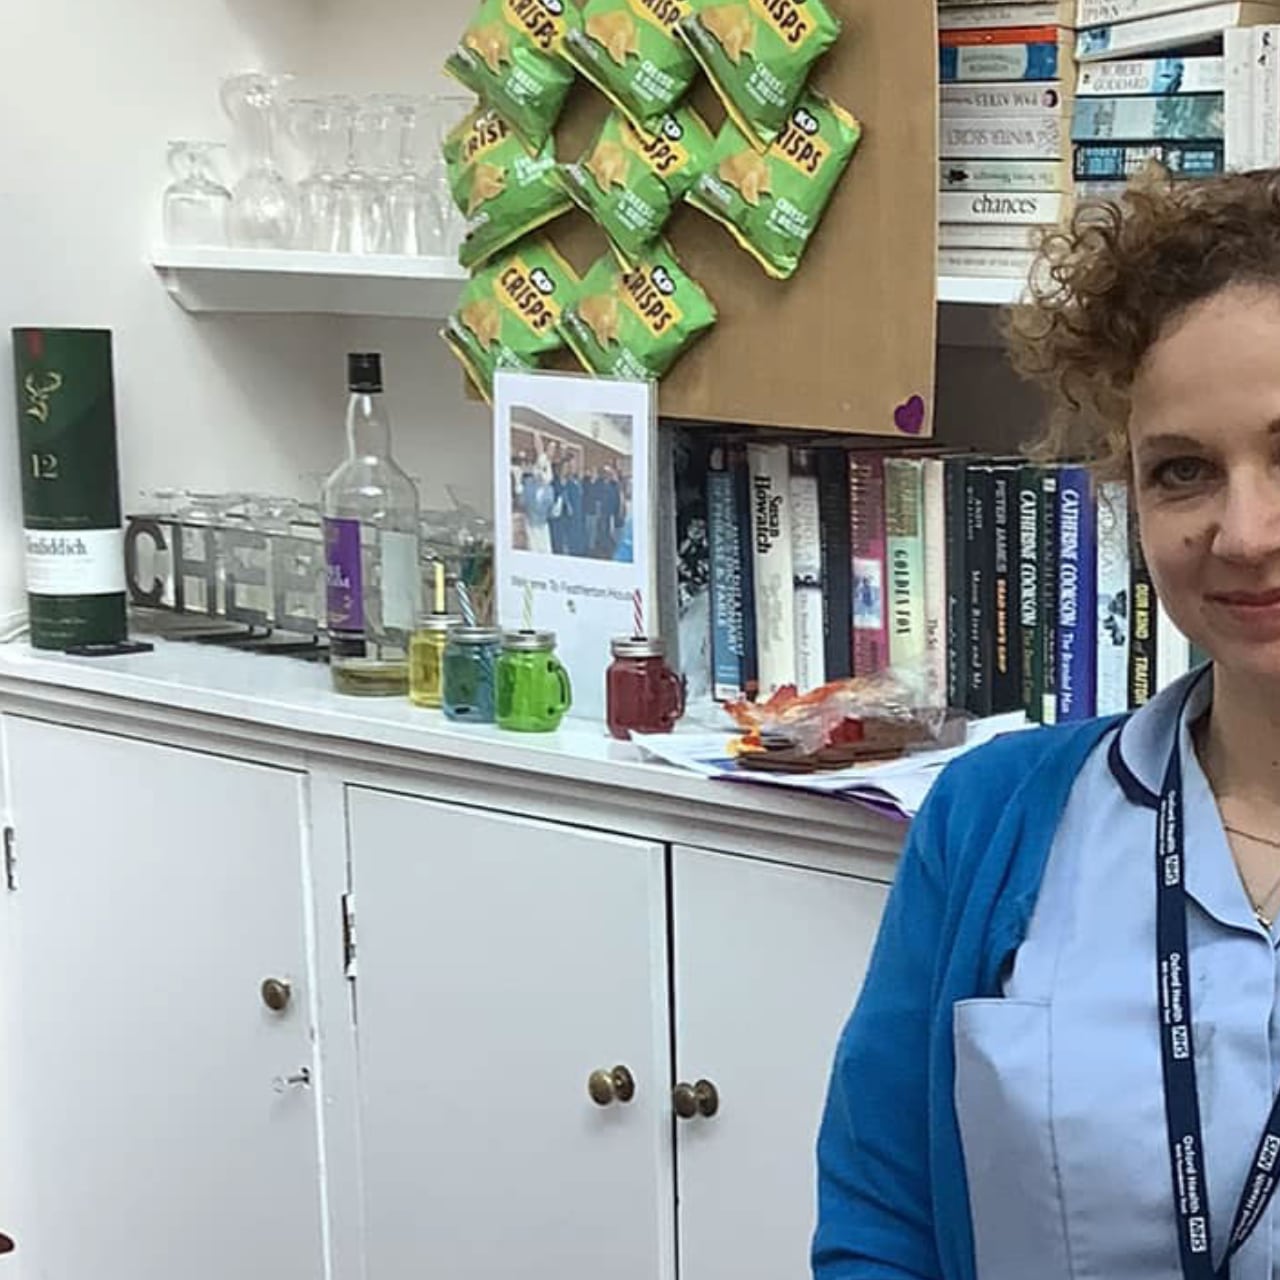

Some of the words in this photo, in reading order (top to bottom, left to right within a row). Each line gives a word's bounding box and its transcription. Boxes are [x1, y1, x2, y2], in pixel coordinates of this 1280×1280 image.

[500, 0, 558, 48] RISPS
[760, 0, 808, 43] RISPS
[776, 122, 823, 173] RISPS
[971, 193, 1038, 214] chances
[501, 267, 553, 330] CRISPS
[31, 453, 59, 479] 12
[753, 475, 771, 555] Howatch
[769, 495, 783, 538] Susan
[995, 480, 1007, 524] PETER
[1019, 490, 1038, 560] CATHERINE
[1060, 488, 1080, 561] CATHERINE
[995, 527, 1007, 573] JAMES
[124, 518, 318, 634] CHEE
[893, 549, 910, 606] GOLDEN
[1020, 562, 1038, 627] COOKSON
[1060, 563, 1078, 627] COOKSON
[895, 609, 911, 635] FOX
[1061, 632, 1075, 651] The
[1169, 952, 1183, 988] Oxford
[1173, 1025, 1190, 1059] NHS
[1182, 1135, 1197, 1175] Oxford
[1256, 1133, 1280, 1172] NHS
[1186, 1176, 1200, 1213] Health
[1189, 1216, 1207, 1253] NHS
